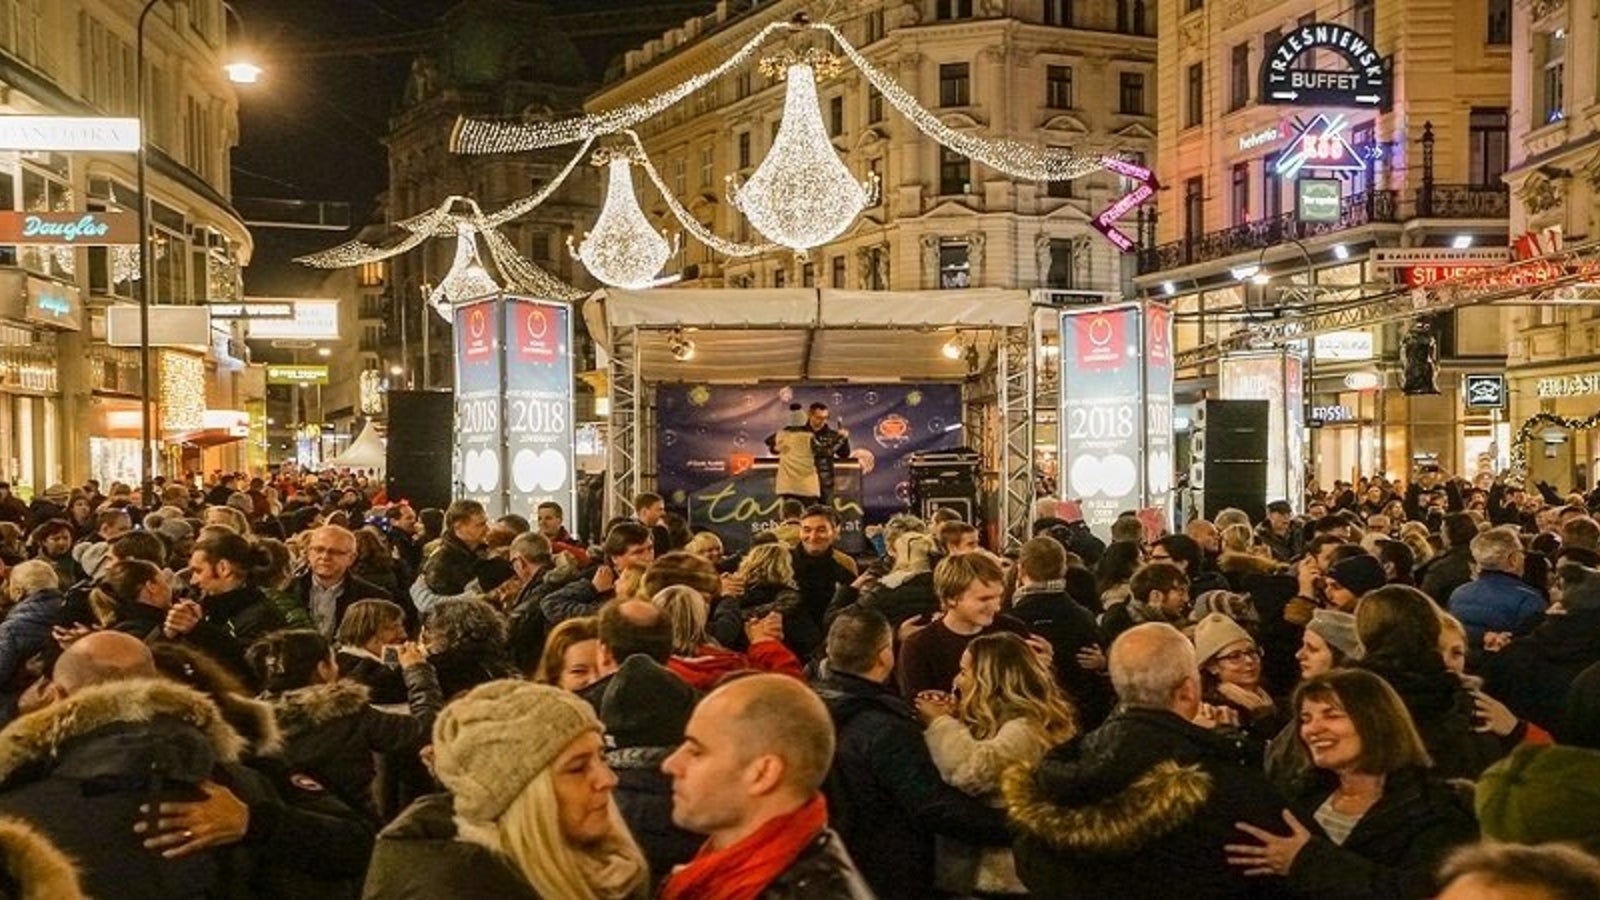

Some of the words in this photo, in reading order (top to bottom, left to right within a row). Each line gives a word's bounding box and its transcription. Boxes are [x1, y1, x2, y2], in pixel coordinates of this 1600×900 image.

[1291, 72, 1359, 90] BUFFET
[22, 214, 109, 242] Douglas
[463, 400, 497, 433] 2018
[510, 400, 565, 433] 2018
[1068, 405, 1133, 439] 2018
